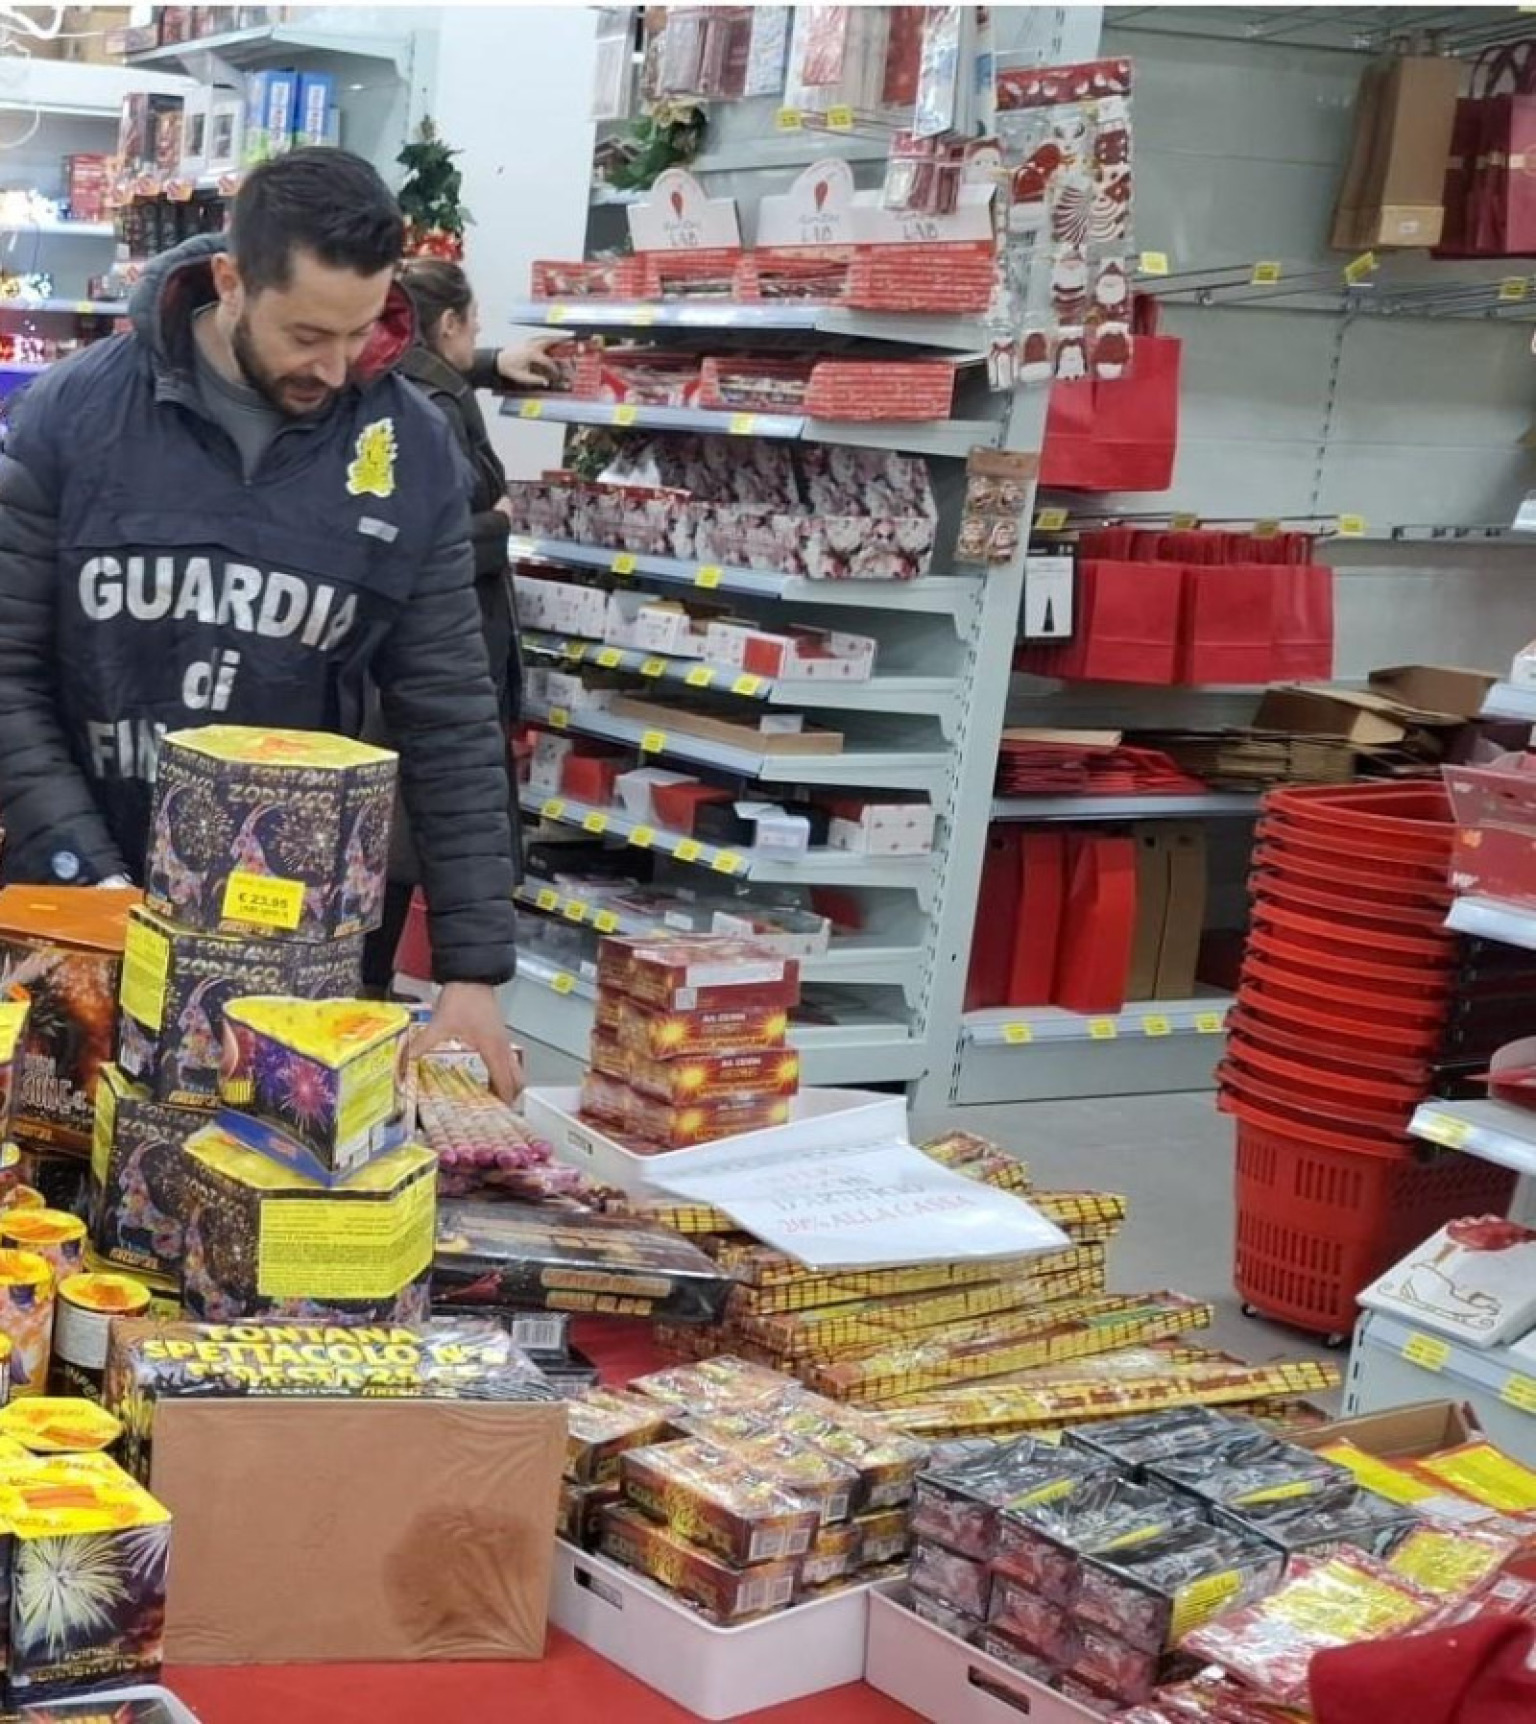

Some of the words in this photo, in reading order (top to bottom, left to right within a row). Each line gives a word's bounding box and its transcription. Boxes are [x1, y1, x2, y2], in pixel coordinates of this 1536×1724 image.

[78, 556, 359, 652] GUARDIA
[182, 647, 240, 712] di
[87, 718, 167, 785] FIN
[227, 784, 336, 808] ZODIACO
[175, 956, 282, 984] ZODIACO
[206, 1326, 422, 1345] FONTANA
[141, 1339, 424, 1367] SPETTACOLO
